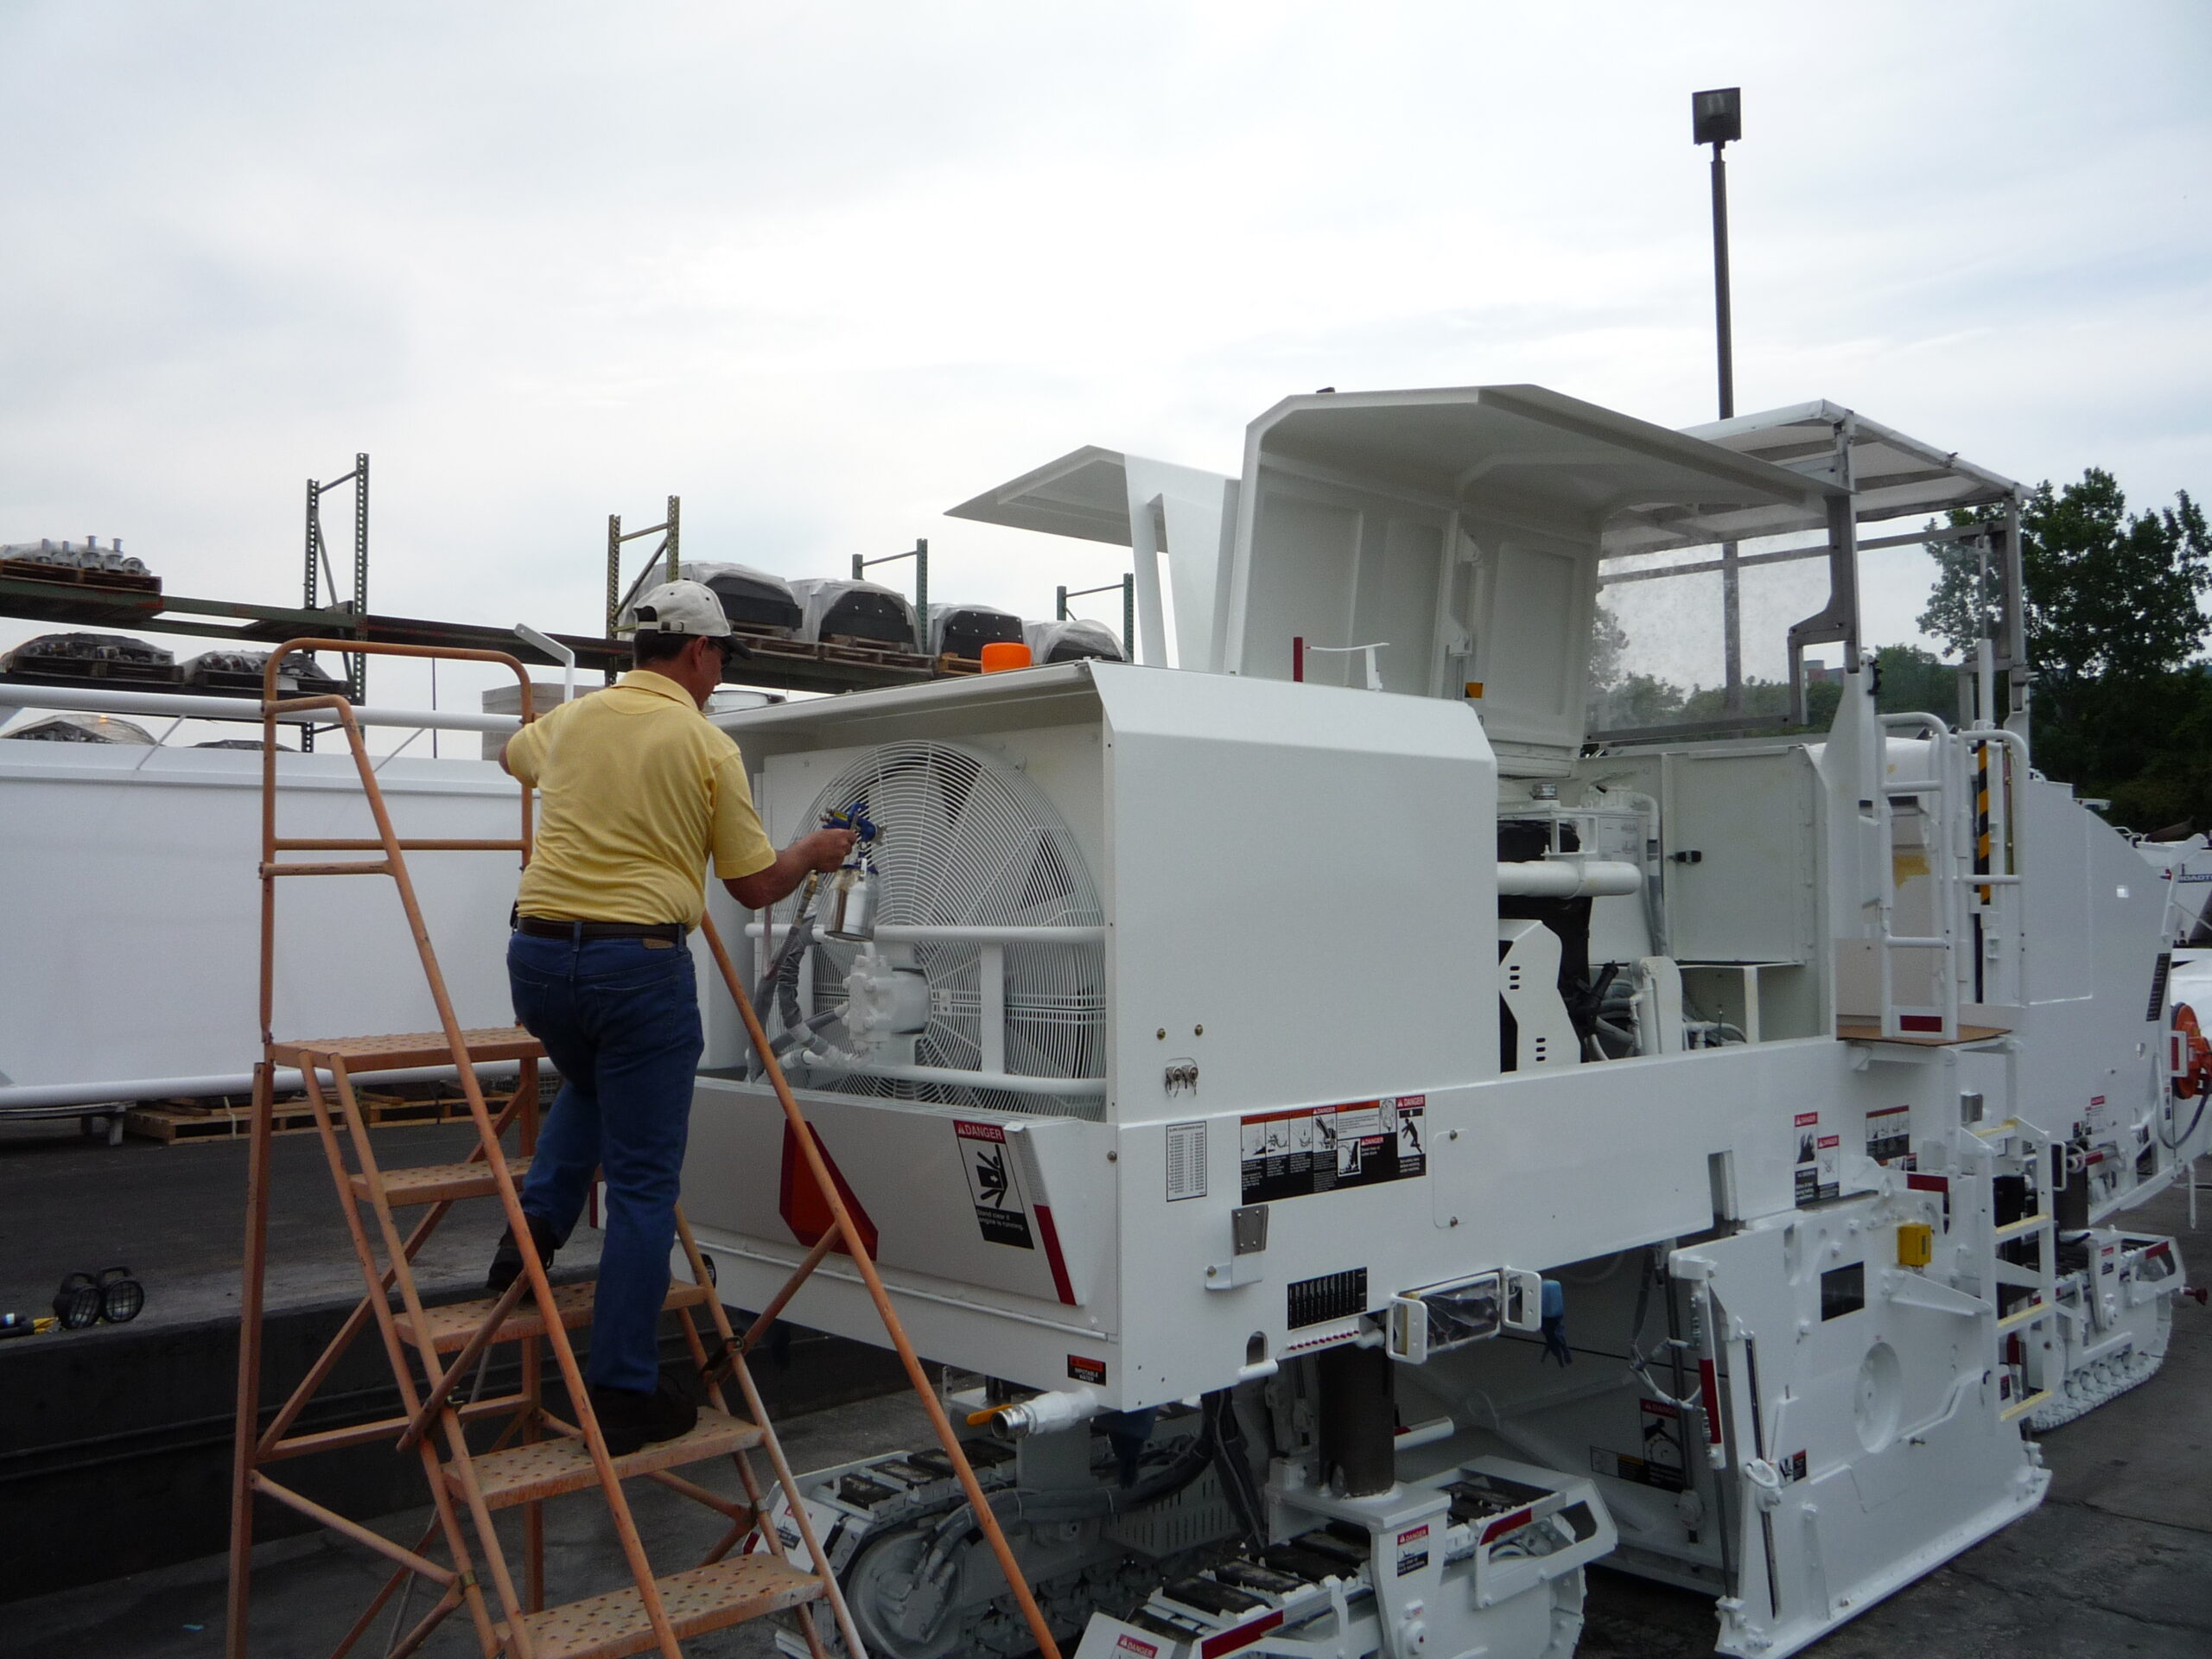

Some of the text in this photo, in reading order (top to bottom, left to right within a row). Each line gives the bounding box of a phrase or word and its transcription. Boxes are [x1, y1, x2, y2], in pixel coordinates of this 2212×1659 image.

[1403, 1096, 1424, 1109] DANGER
[964, 1126, 1002, 1141] DANGER
[1364, 1137, 1384, 1146] DANGER
[1079, 1373, 1095, 1382] WATER
[1406, 1529, 1427, 1541] DANGER
[1127, 1642, 1154, 1657] DANGER
